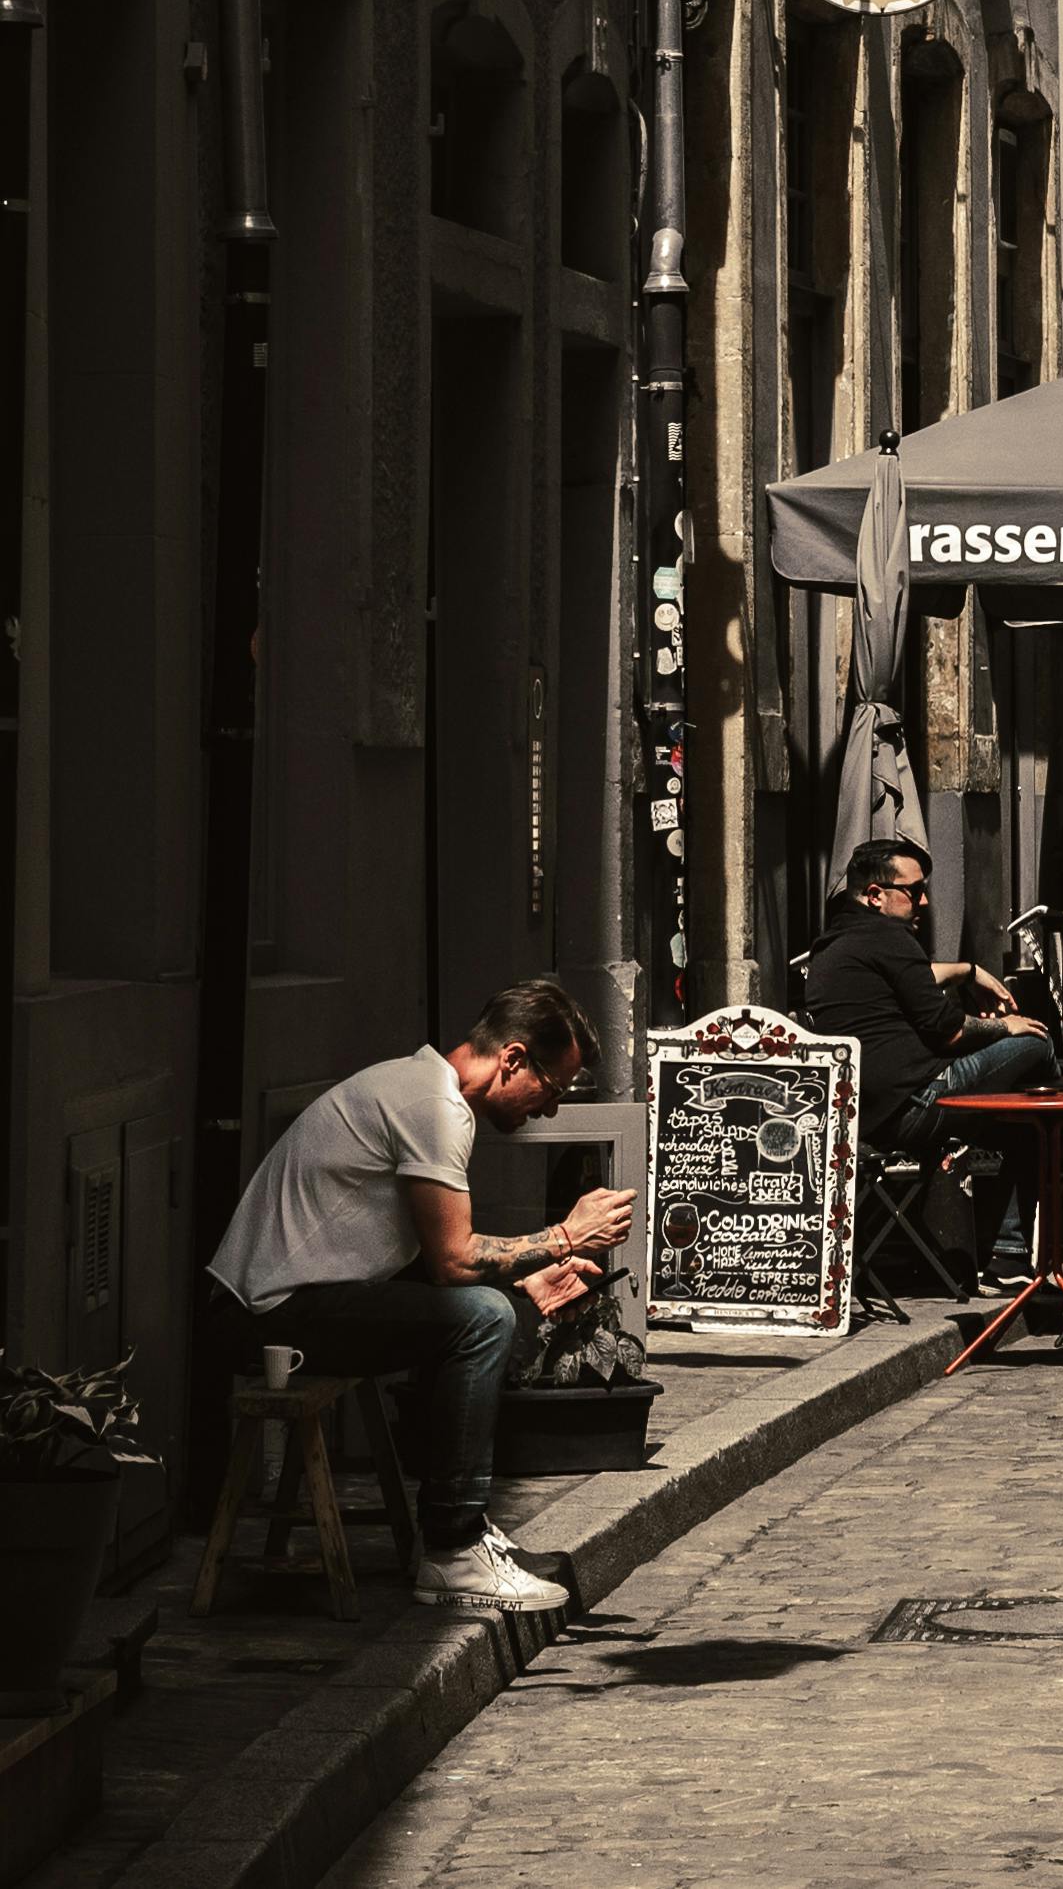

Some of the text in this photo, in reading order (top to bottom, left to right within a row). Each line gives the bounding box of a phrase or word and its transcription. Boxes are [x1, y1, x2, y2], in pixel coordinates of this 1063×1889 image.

[669, 1107, 724, 1138] tapas
[703, 1124, 758, 1142] SALADS
[664, 1134, 722, 1154] chocolate
[675, 1150, 716, 1164] carrot
[660, 1179, 748, 1193] sandwiches
[753, 1174, 802, 1191] draft
[756, 1189, 794, 1202] BEER
[757, 1213, 823, 1232] DRINKS
[712, 1244, 742, 1257] HOME
[712, 1256, 741, 1269] MADE
[751, 1272, 817, 1286] ESPRESSO
[748, 1288, 819, 1304] CAPPUCCINO
